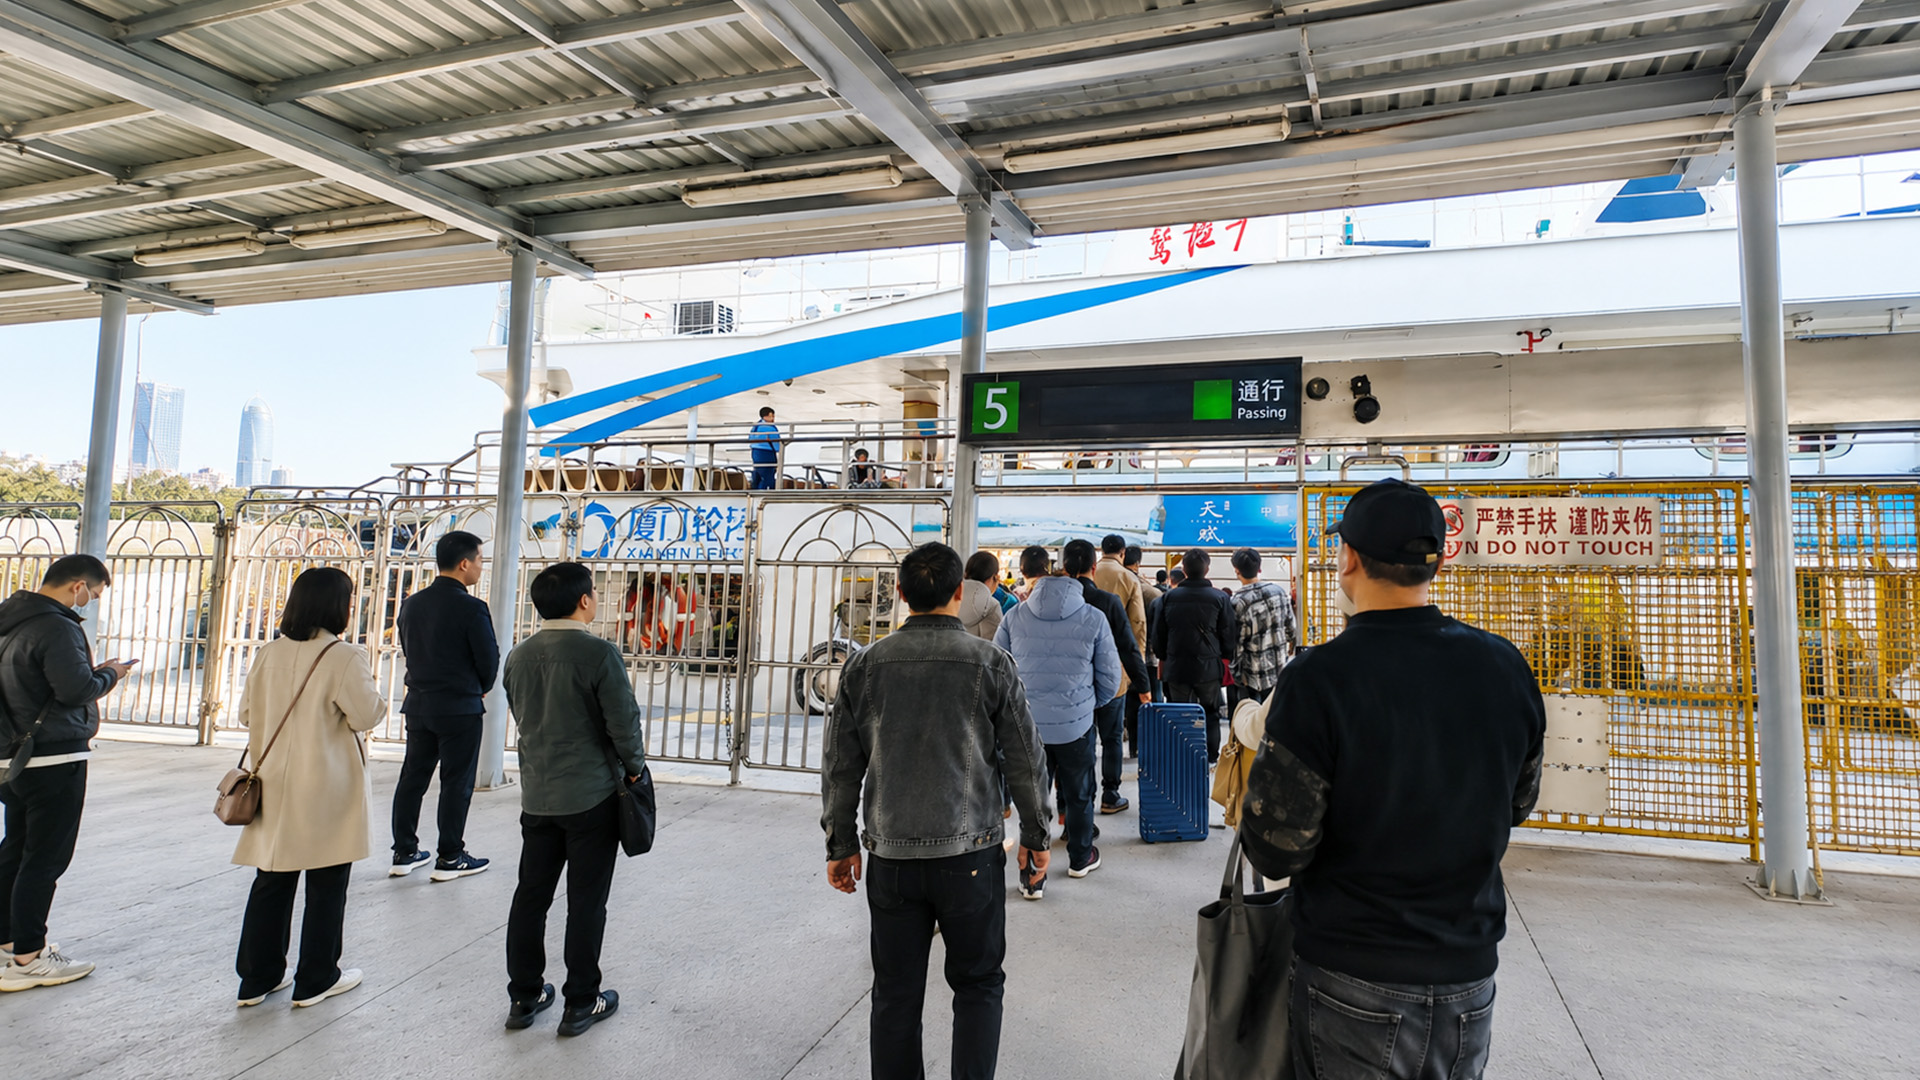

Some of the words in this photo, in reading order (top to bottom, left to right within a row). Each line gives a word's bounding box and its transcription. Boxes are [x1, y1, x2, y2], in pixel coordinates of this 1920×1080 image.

[1237, 379, 1285, 402] 通行
[983, 387, 1008, 430] 5
[1237, 406, 1287, 421] Passing
[1476, 506, 1557, 536] 严禁手扶
[1568, 506, 1653, 536] 谨防夹伤
[1487, 540, 1517, 555] DO
[1525, 540, 1570, 555] NOT
[1577, 540, 1653, 556] TOUCH
